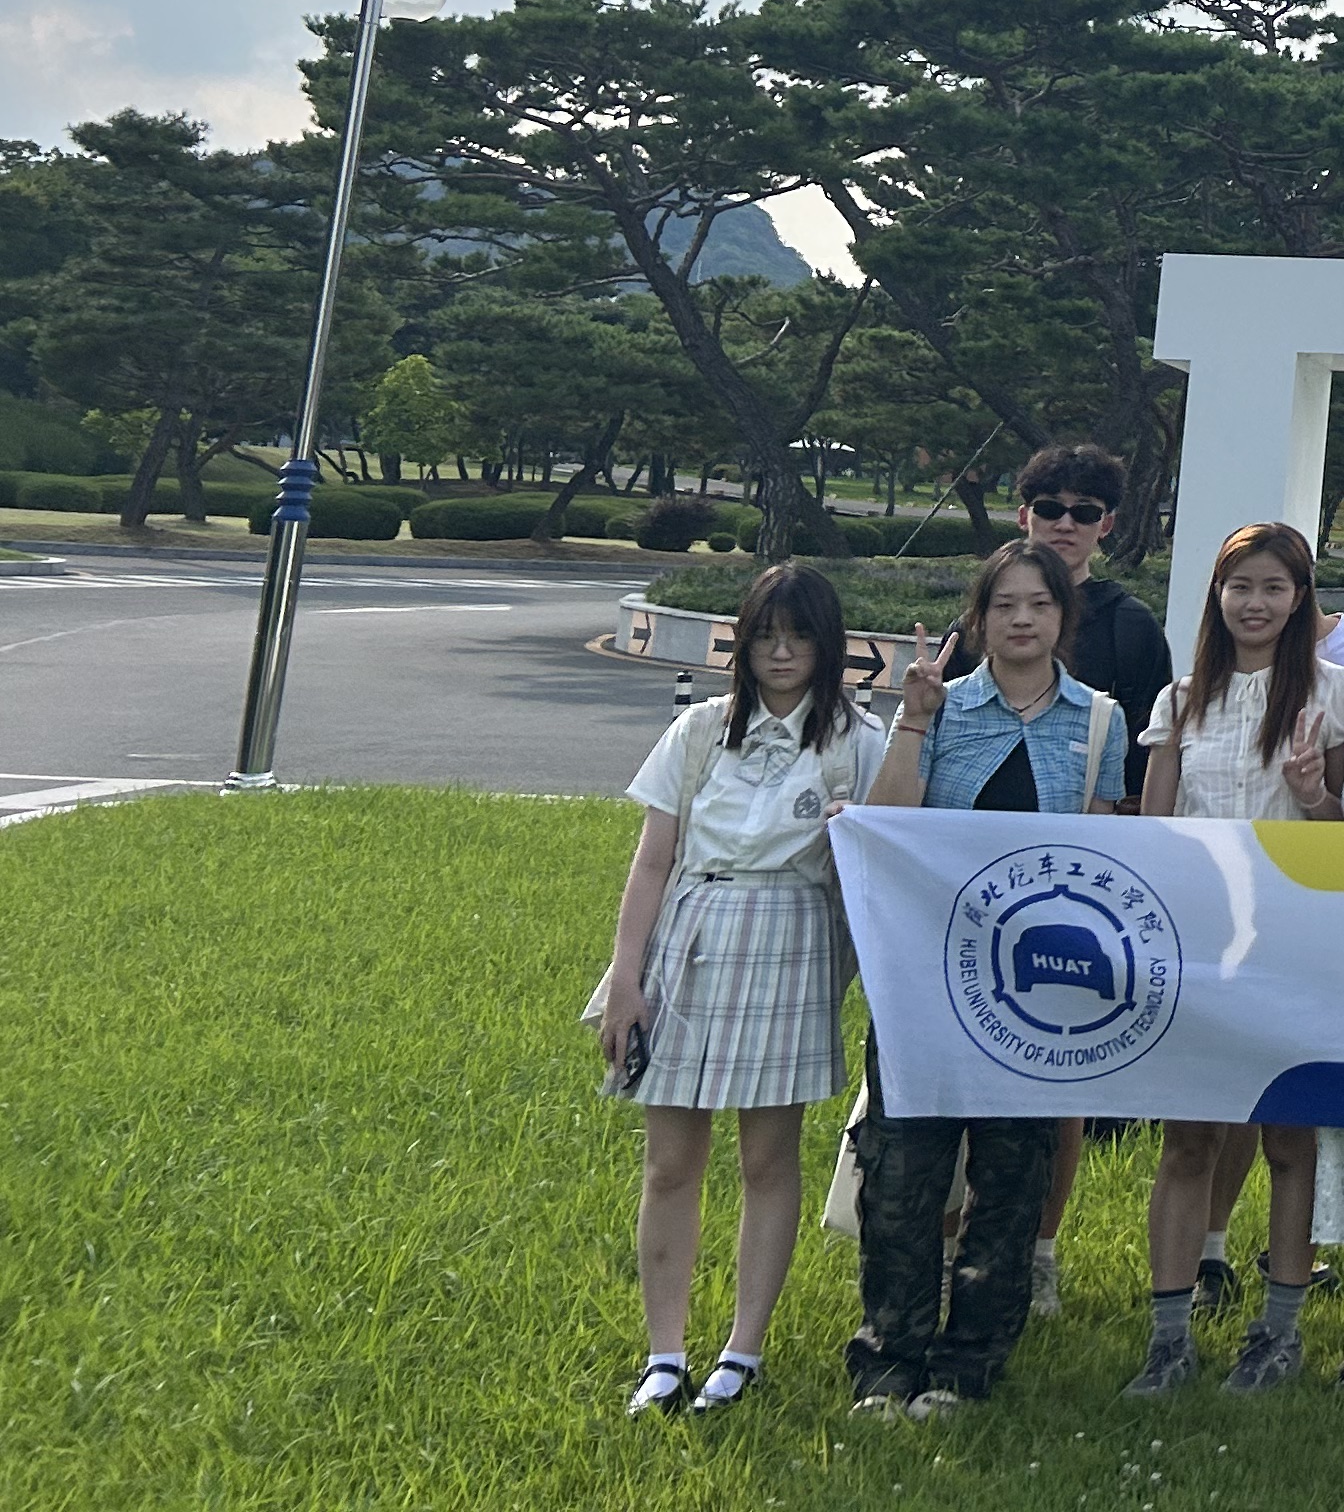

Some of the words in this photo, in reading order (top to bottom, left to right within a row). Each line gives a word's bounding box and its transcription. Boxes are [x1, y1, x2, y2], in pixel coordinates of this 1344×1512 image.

[960, 938, 979, 983] HUBEI
[1031, 952, 1093, 975] HUAT
[1129, 957, 1167, 1036] TECHNOLOGY
[964, 982, 1026, 1055] UNIVERSITY
[1024, 1042, 1046, 1062] OF
[1045, 1029, 1137, 1067] AUTOMOTIVE
